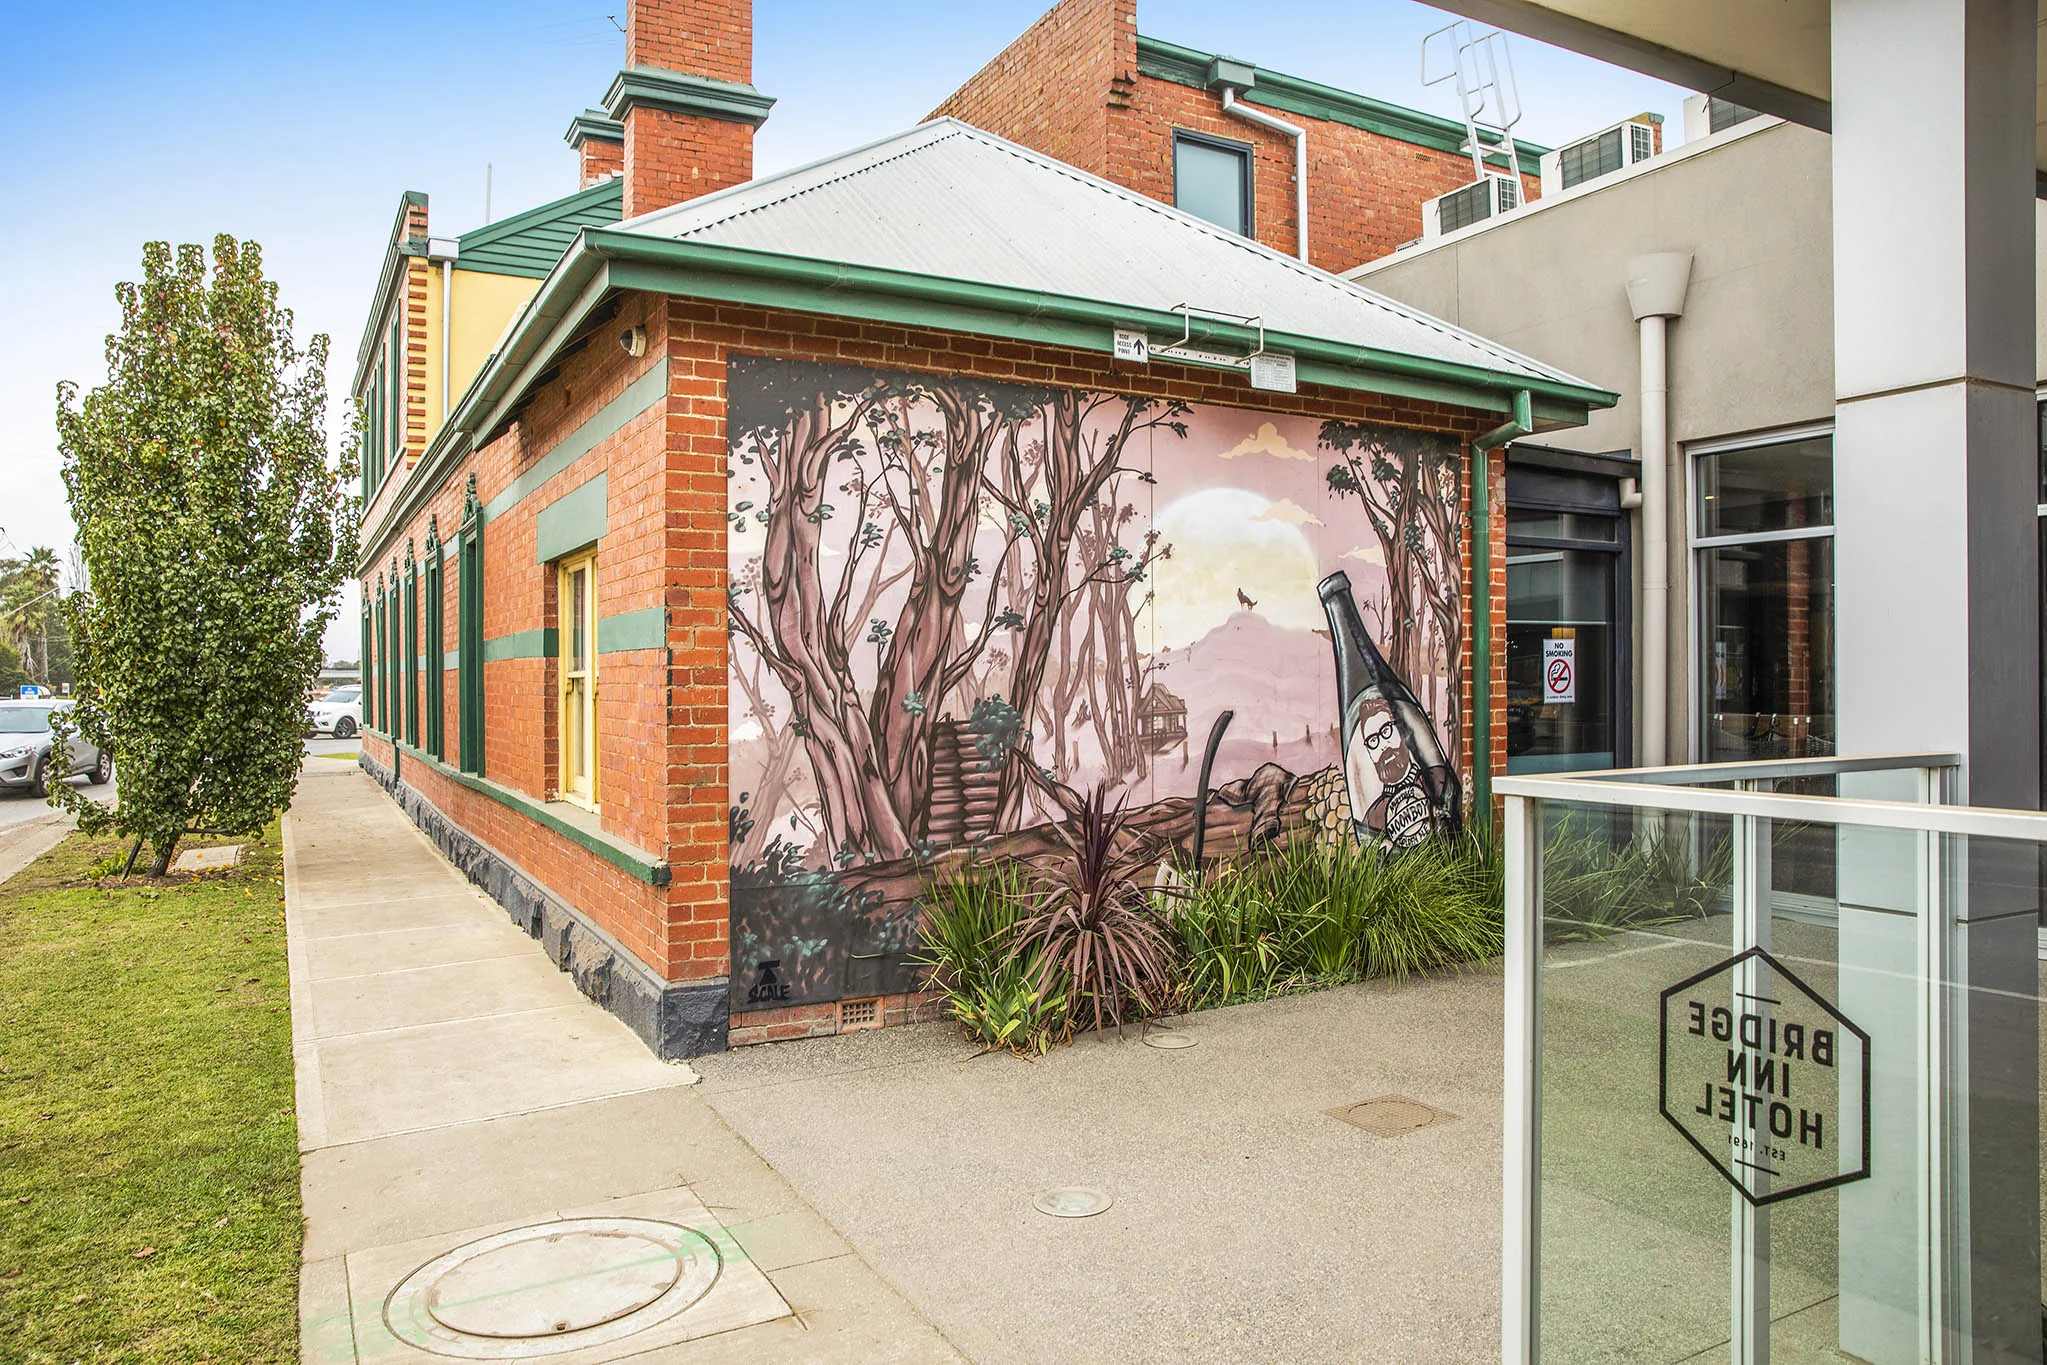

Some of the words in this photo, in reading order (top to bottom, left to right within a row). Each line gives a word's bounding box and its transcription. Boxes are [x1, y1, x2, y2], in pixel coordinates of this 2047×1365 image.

[1117, 340, 1133, 349] ACCESS
[1118, 347, 1131, 355] POINT
[1545, 650, 1573, 658] SMOKING
[747, 984, 791, 1003] SCALE
